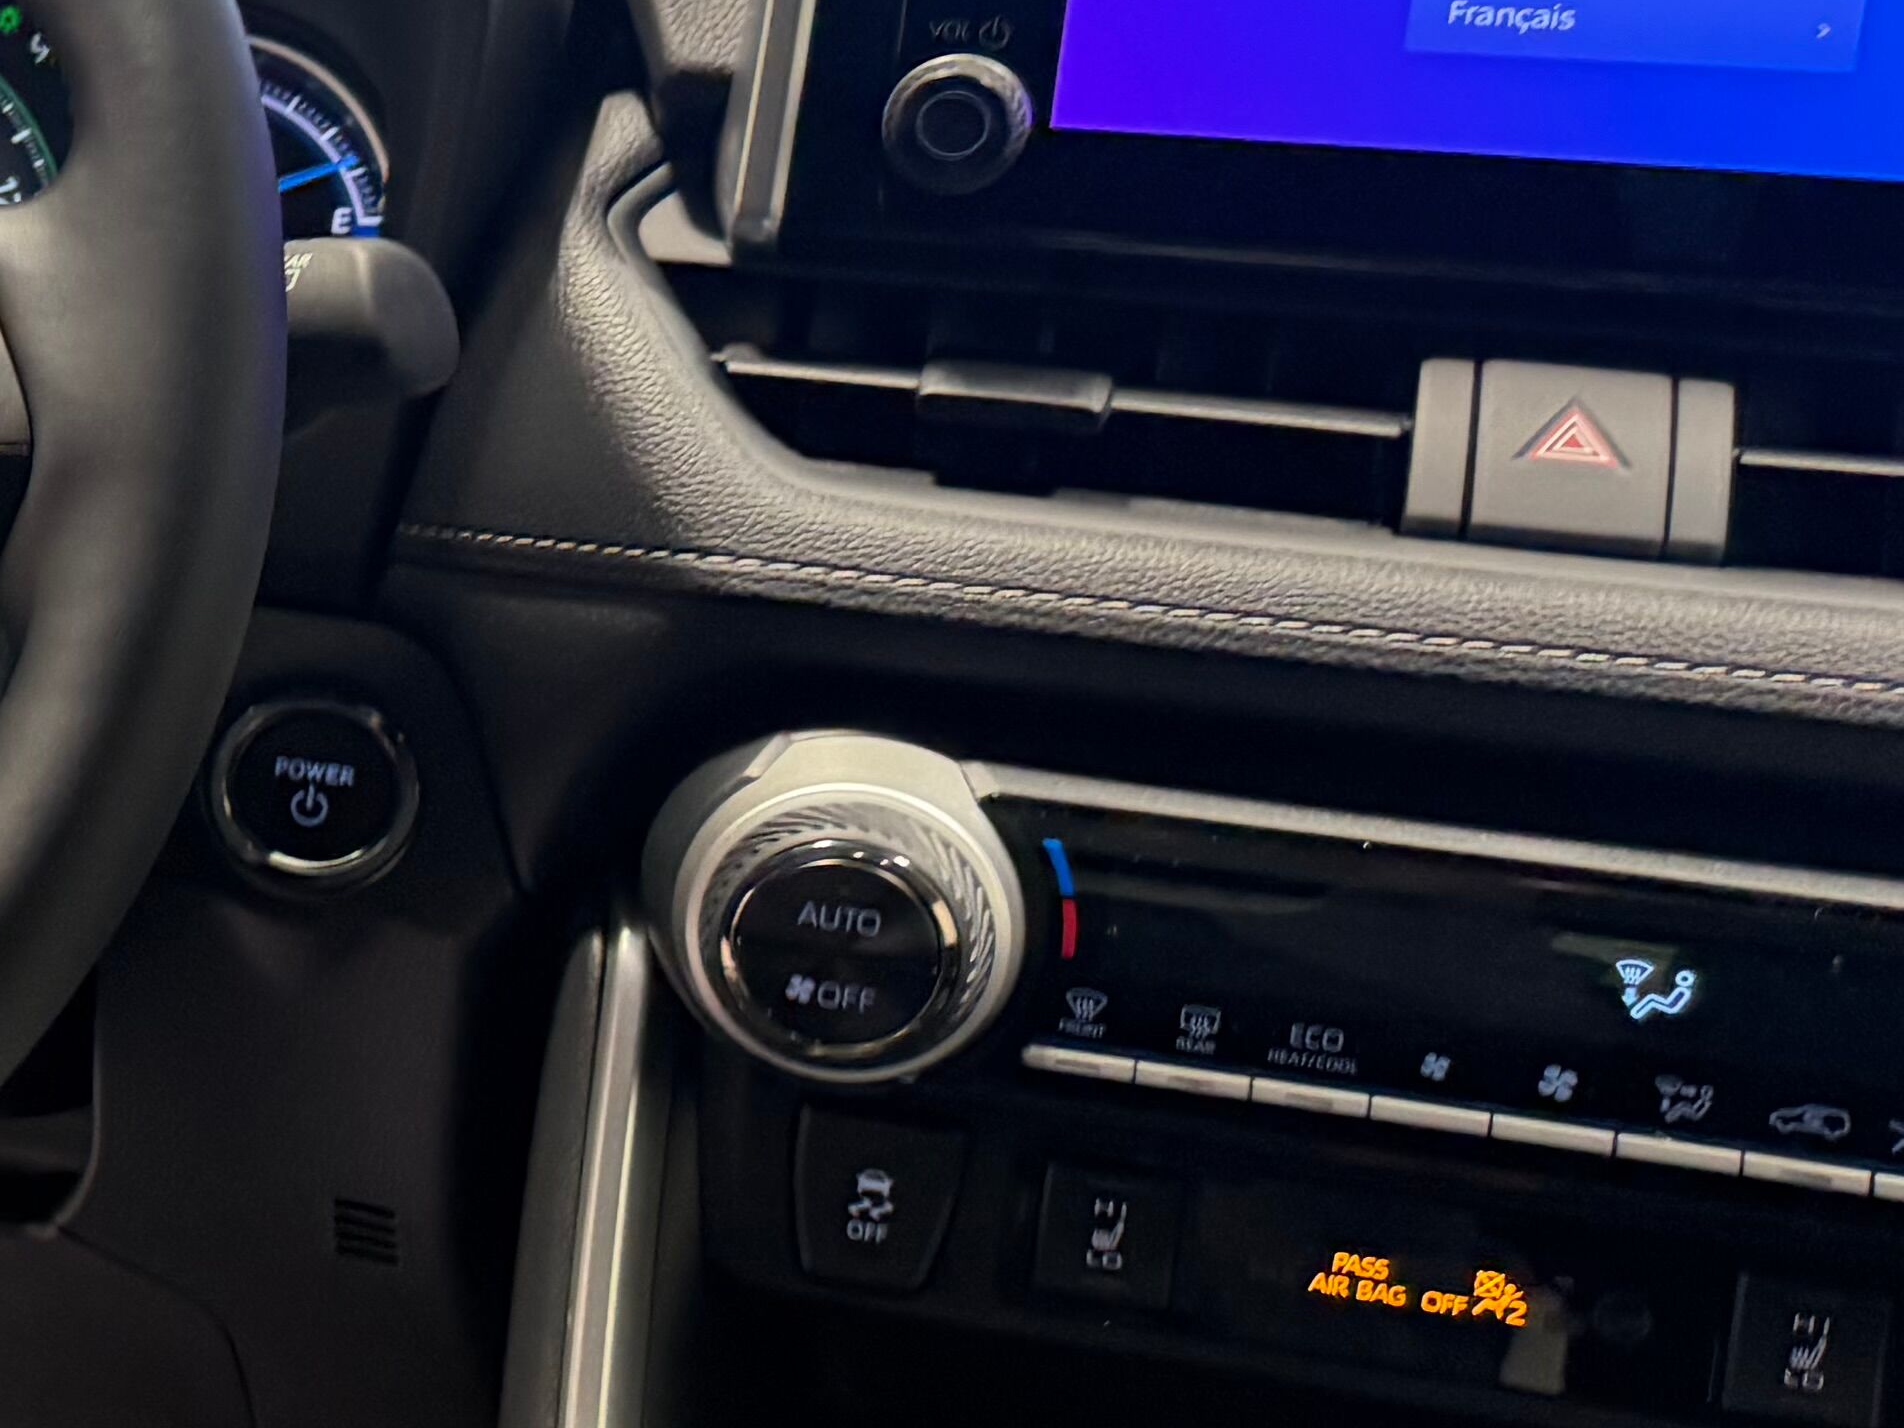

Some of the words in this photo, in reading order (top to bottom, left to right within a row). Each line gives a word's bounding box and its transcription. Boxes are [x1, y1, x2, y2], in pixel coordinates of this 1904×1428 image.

[1447, 0, 1576, 35] Français
[330, 207, 353, 235] E
[274, 755, 354, 787] POWER
[797, 900, 882, 938] AUTO
[817, 980, 876, 1014] OFF
[1290, 1022, 1345, 1054] ECO
[1332, 1251, 1391, 1281] PASS
[1307, 1272, 1350, 1298] AIR
[1355, 1279, 1407, 1307] BAG
[1421, 1290, 1469, 1316] OFF
